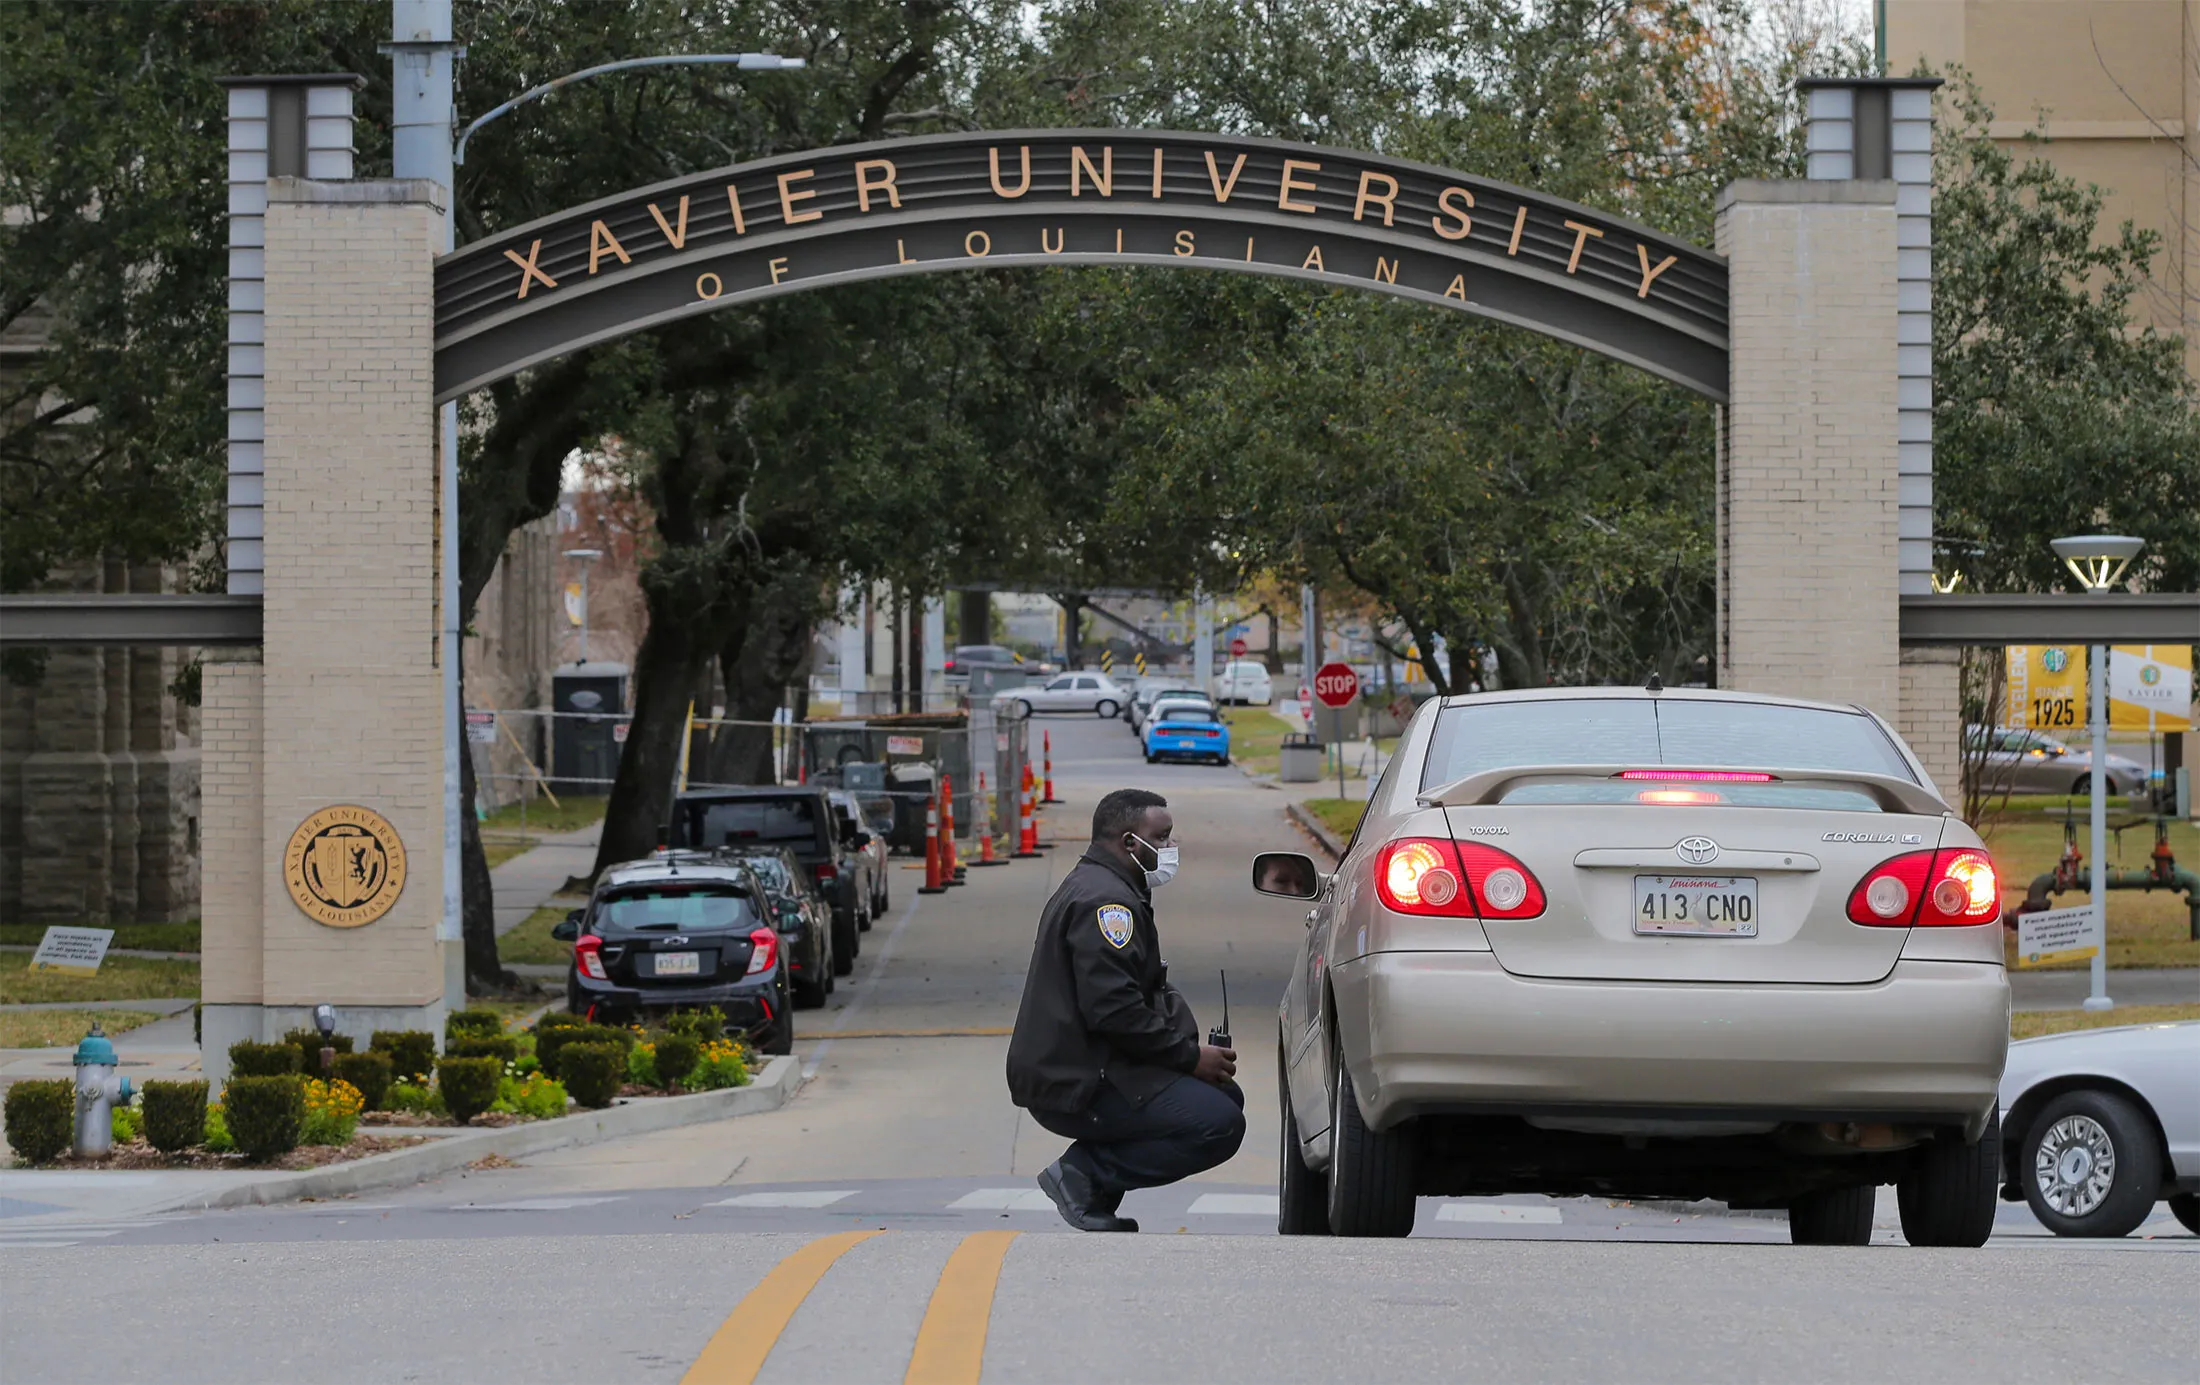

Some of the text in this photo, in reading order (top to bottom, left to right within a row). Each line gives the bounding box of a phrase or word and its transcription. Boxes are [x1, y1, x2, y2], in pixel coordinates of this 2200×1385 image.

[503, 145, 1678, 299] XAVIER UNIVERSITY
[695, 228, 1467, 301] OF LOUISIANA
[1316, 674, 1355, 695] STOP
[2034, 686, 2074, 698] SINCE
[2128, 689, 2172, 697] XAVIER
[2033, 698, 2074, 726] 1925
[1470, 826, 1509, 835] TOYOTA
[289, 810, 400, 872] XAVIER UNIVERSITY
[1822, 832, 1896, 843] COROLLA
[1669, 878, 1728, 889] Louisiana
[300, 892, 393, 921] OF LOUISIANA
[1642, 893, 1752, 922] 413 CNO
[2048, 913, 2076, 921] masks
[2034, 920, 2083, 932] mandatory
[2049, 930, 2079, 938] spaces
[2041, 939, 2076, 948] campus
